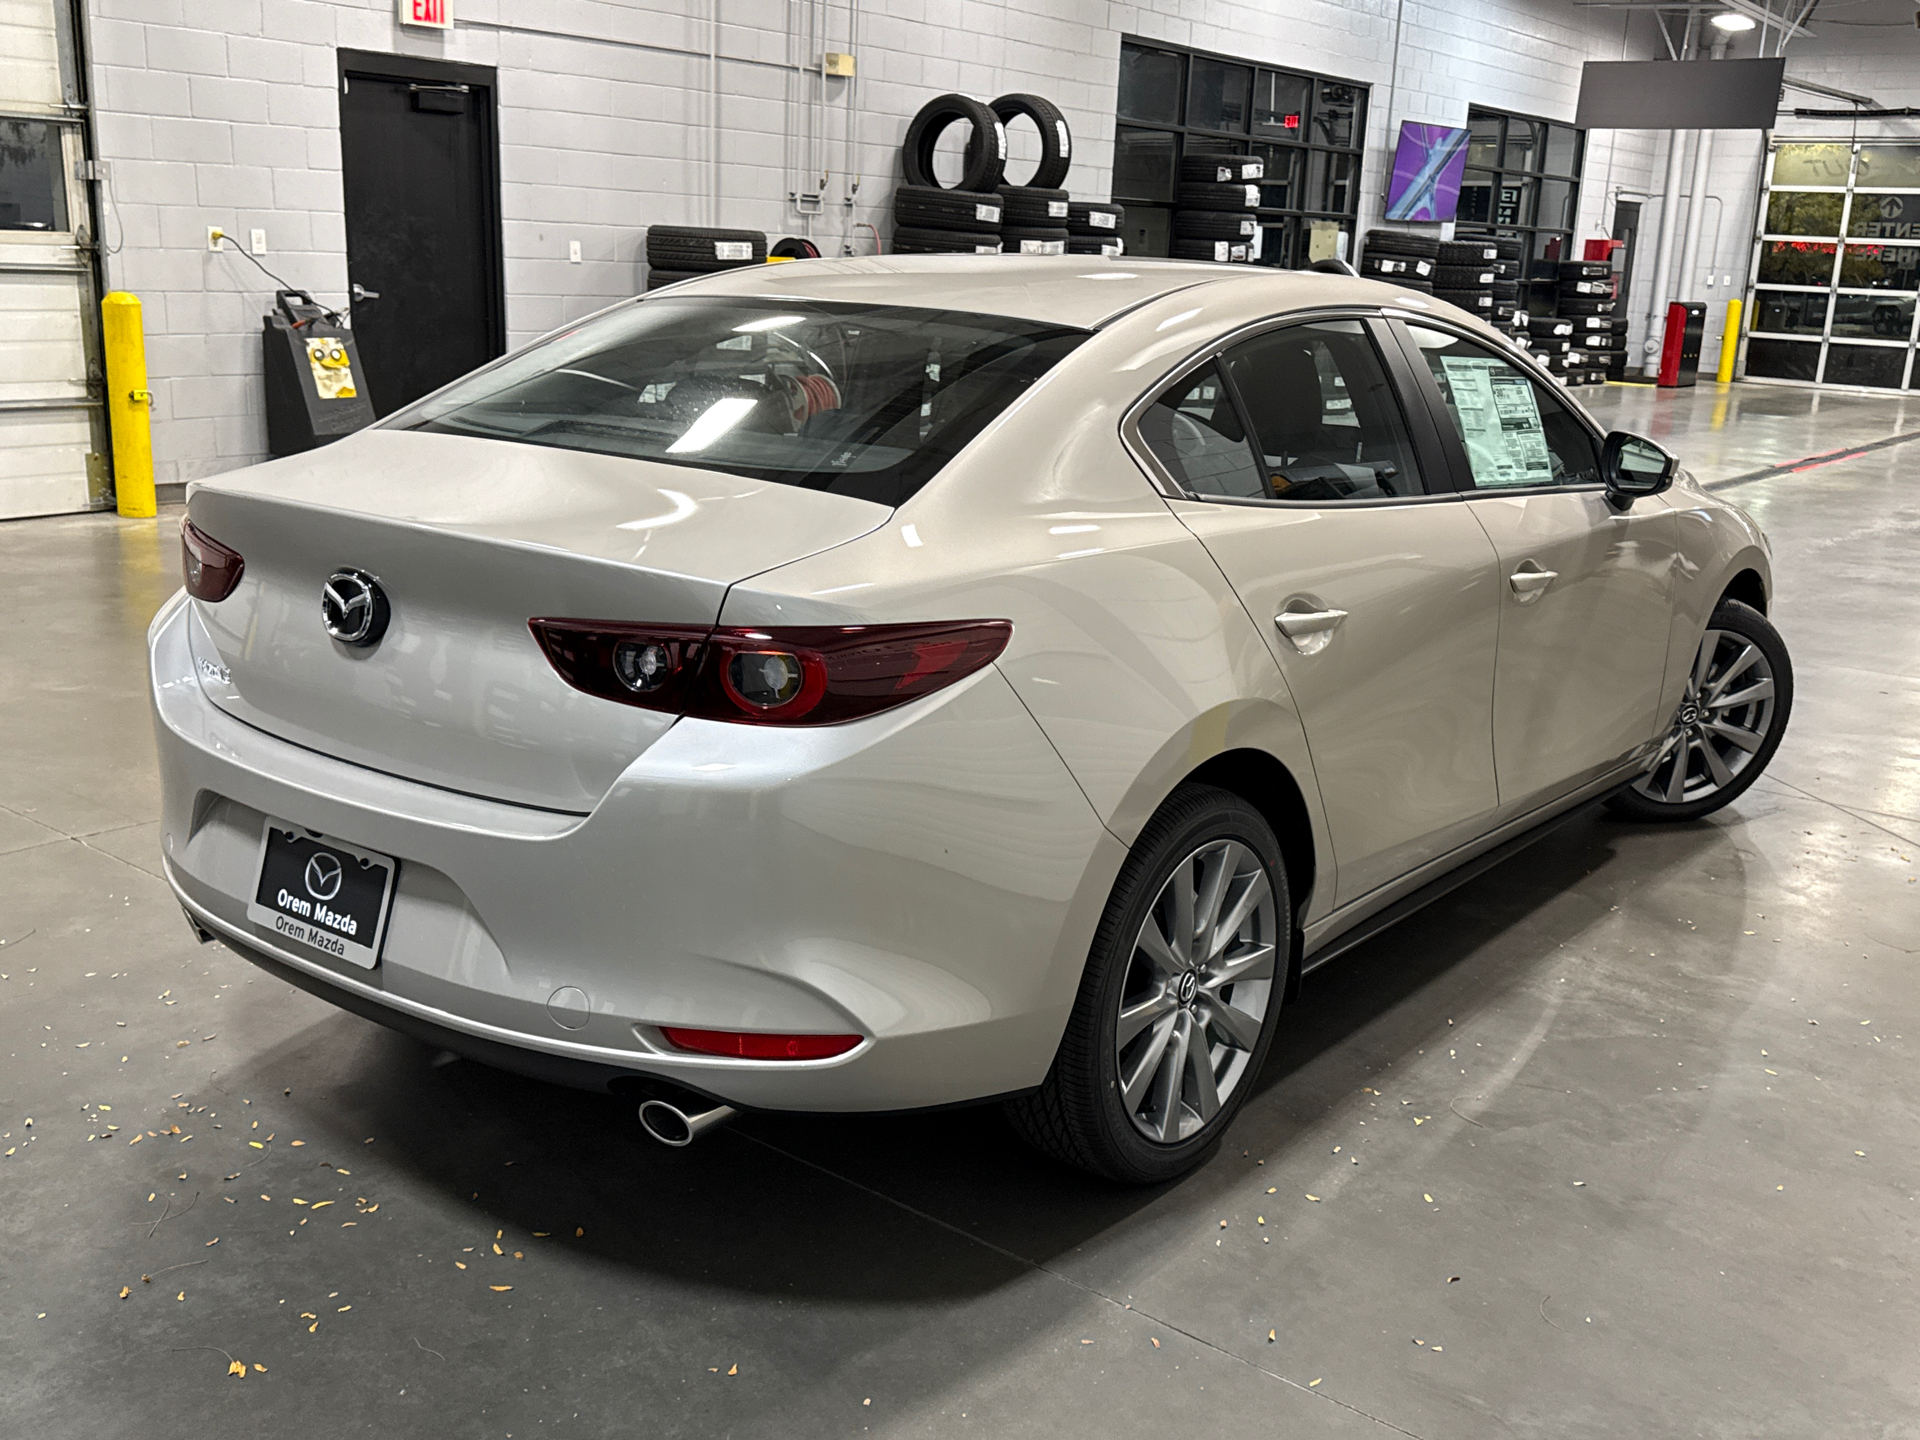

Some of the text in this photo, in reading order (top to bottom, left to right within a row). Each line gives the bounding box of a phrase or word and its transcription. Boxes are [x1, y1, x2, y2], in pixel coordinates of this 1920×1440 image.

[412, 0, 445, 24] EXIT
[277, 888, 358, 936] Orem Mazda
[275, 915, 346, 956] Orem Mazda
